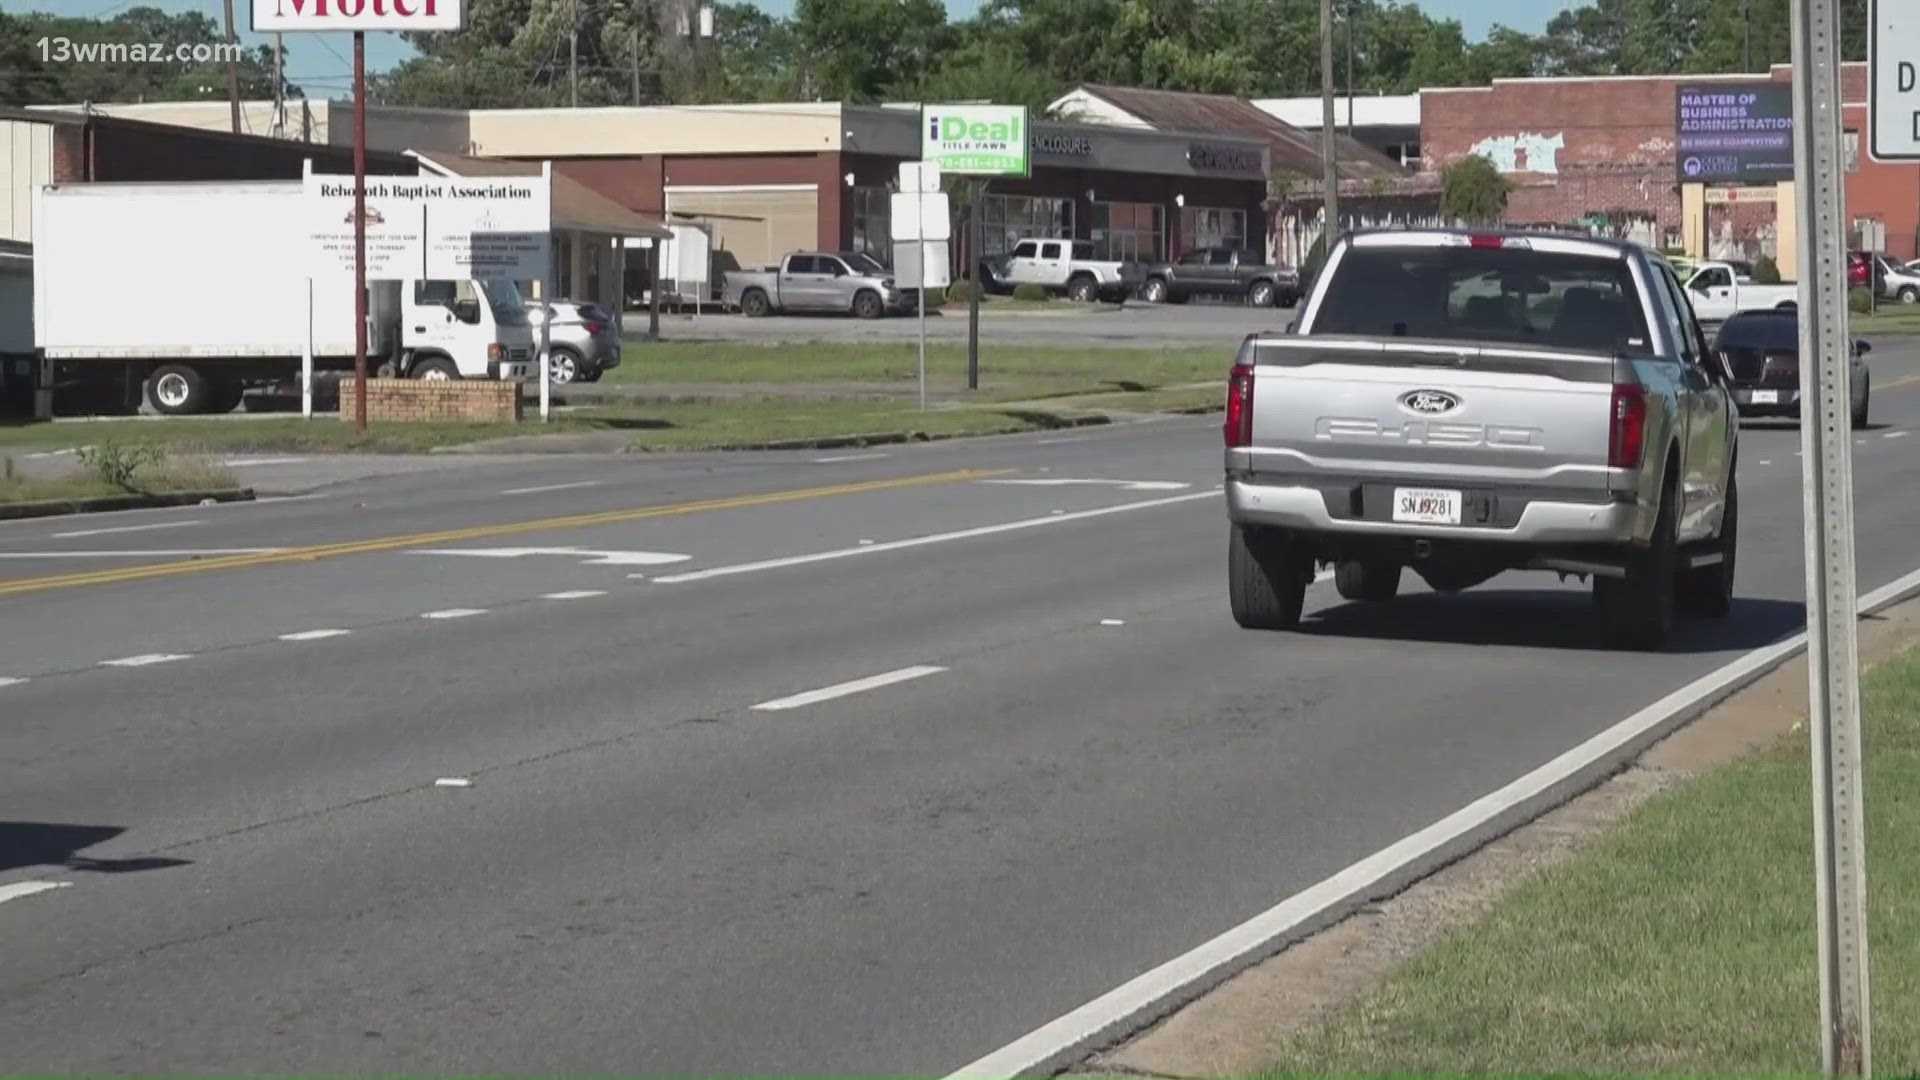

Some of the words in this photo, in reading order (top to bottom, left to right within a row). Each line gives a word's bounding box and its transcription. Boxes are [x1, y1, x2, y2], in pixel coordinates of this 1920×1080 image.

[1681, 94, 1735, 106] MASTER
[1738, 93, 1757, 105] OF
[1681, 106, 1747, 118] BUSINESS
[930, 116, 1019, 142] iDeal
[1681, 118, 1794, 131] ADMINISTRATION
[943, 142, 970, 150] TITLE
[975, 142, 1007, 150] PAWN
[1694, 139, 1720, 148] MORE
[1722, 137, 1784, 147] COMPETITIVE
[320, 183, 388, 198] Rehooth
[393, 183, 442, 201] Baptist
[448, 184, 532, 199] Association
[1412, 392, 1449, 410] Ford
